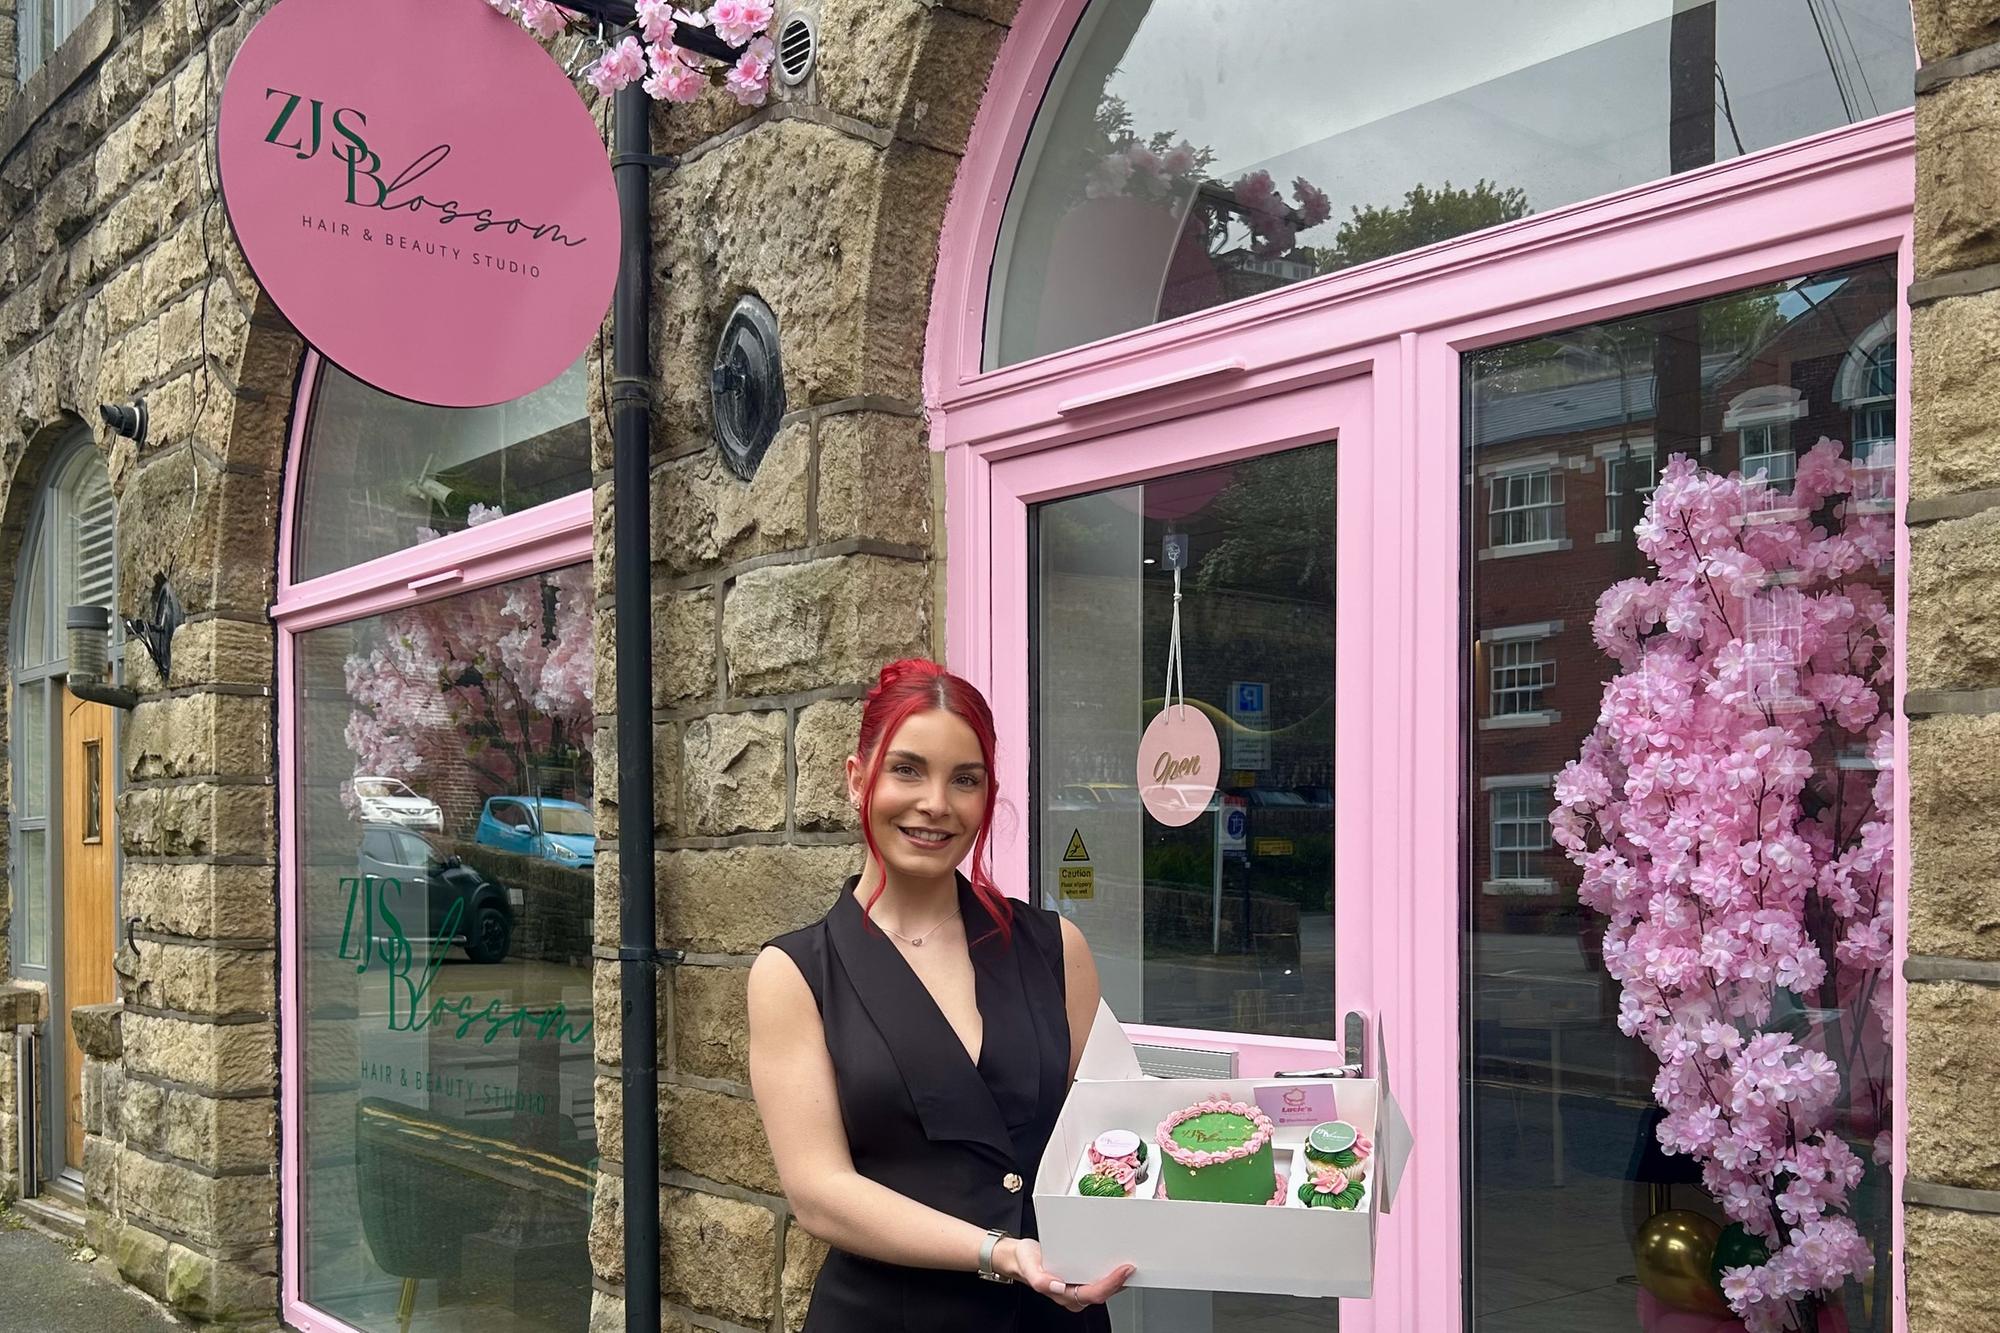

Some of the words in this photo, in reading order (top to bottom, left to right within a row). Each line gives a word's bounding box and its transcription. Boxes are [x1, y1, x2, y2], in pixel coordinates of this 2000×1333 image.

[264, 88, 368, 165] ZJS
[345, 144, 588, 247] Blossom
[302, 215, 351, 237] HAIR
[362, 228, 374, 242] &
[385, 233, 461, 261] BEAUTY
[472, 252, 542, 278] STUDIO
[1153, 751, 1201, 790] Open
[1061, 869, 1091, 878] Caution
[338, 877, 403, 974] ZJS
[388, 896, 593, 1044] Blossom
[361, 1060, 392, 1083] HAIR
[400, 1067, 408, 1087] &
[415, 1070, 475, 1101] BEAUTY
[483, 1084, 546, 1114] STUDIO
[1281, 1105, 1313, 1113] Lucie's
